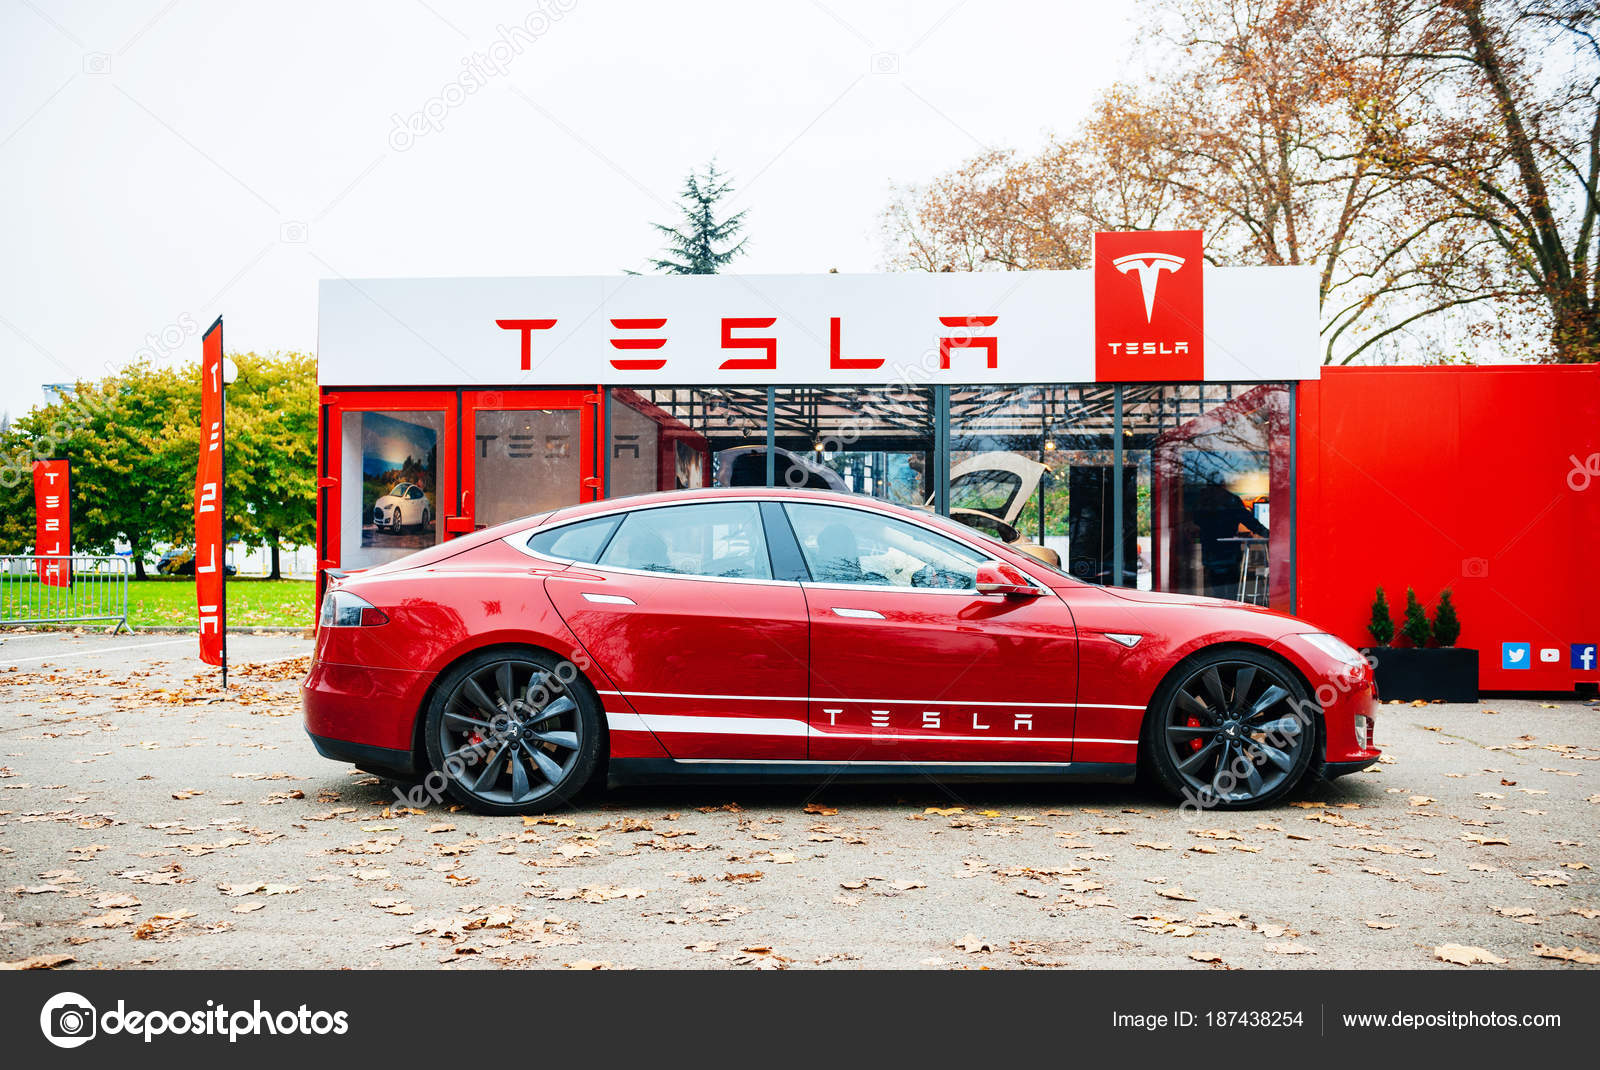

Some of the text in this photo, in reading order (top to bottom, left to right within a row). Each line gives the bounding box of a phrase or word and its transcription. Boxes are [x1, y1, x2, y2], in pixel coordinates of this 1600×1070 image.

[496, 316, 998, 371] TESLA
[1108, 342, 1189, 355] TESLA
[823, 709, 1033, 731] TESLA
